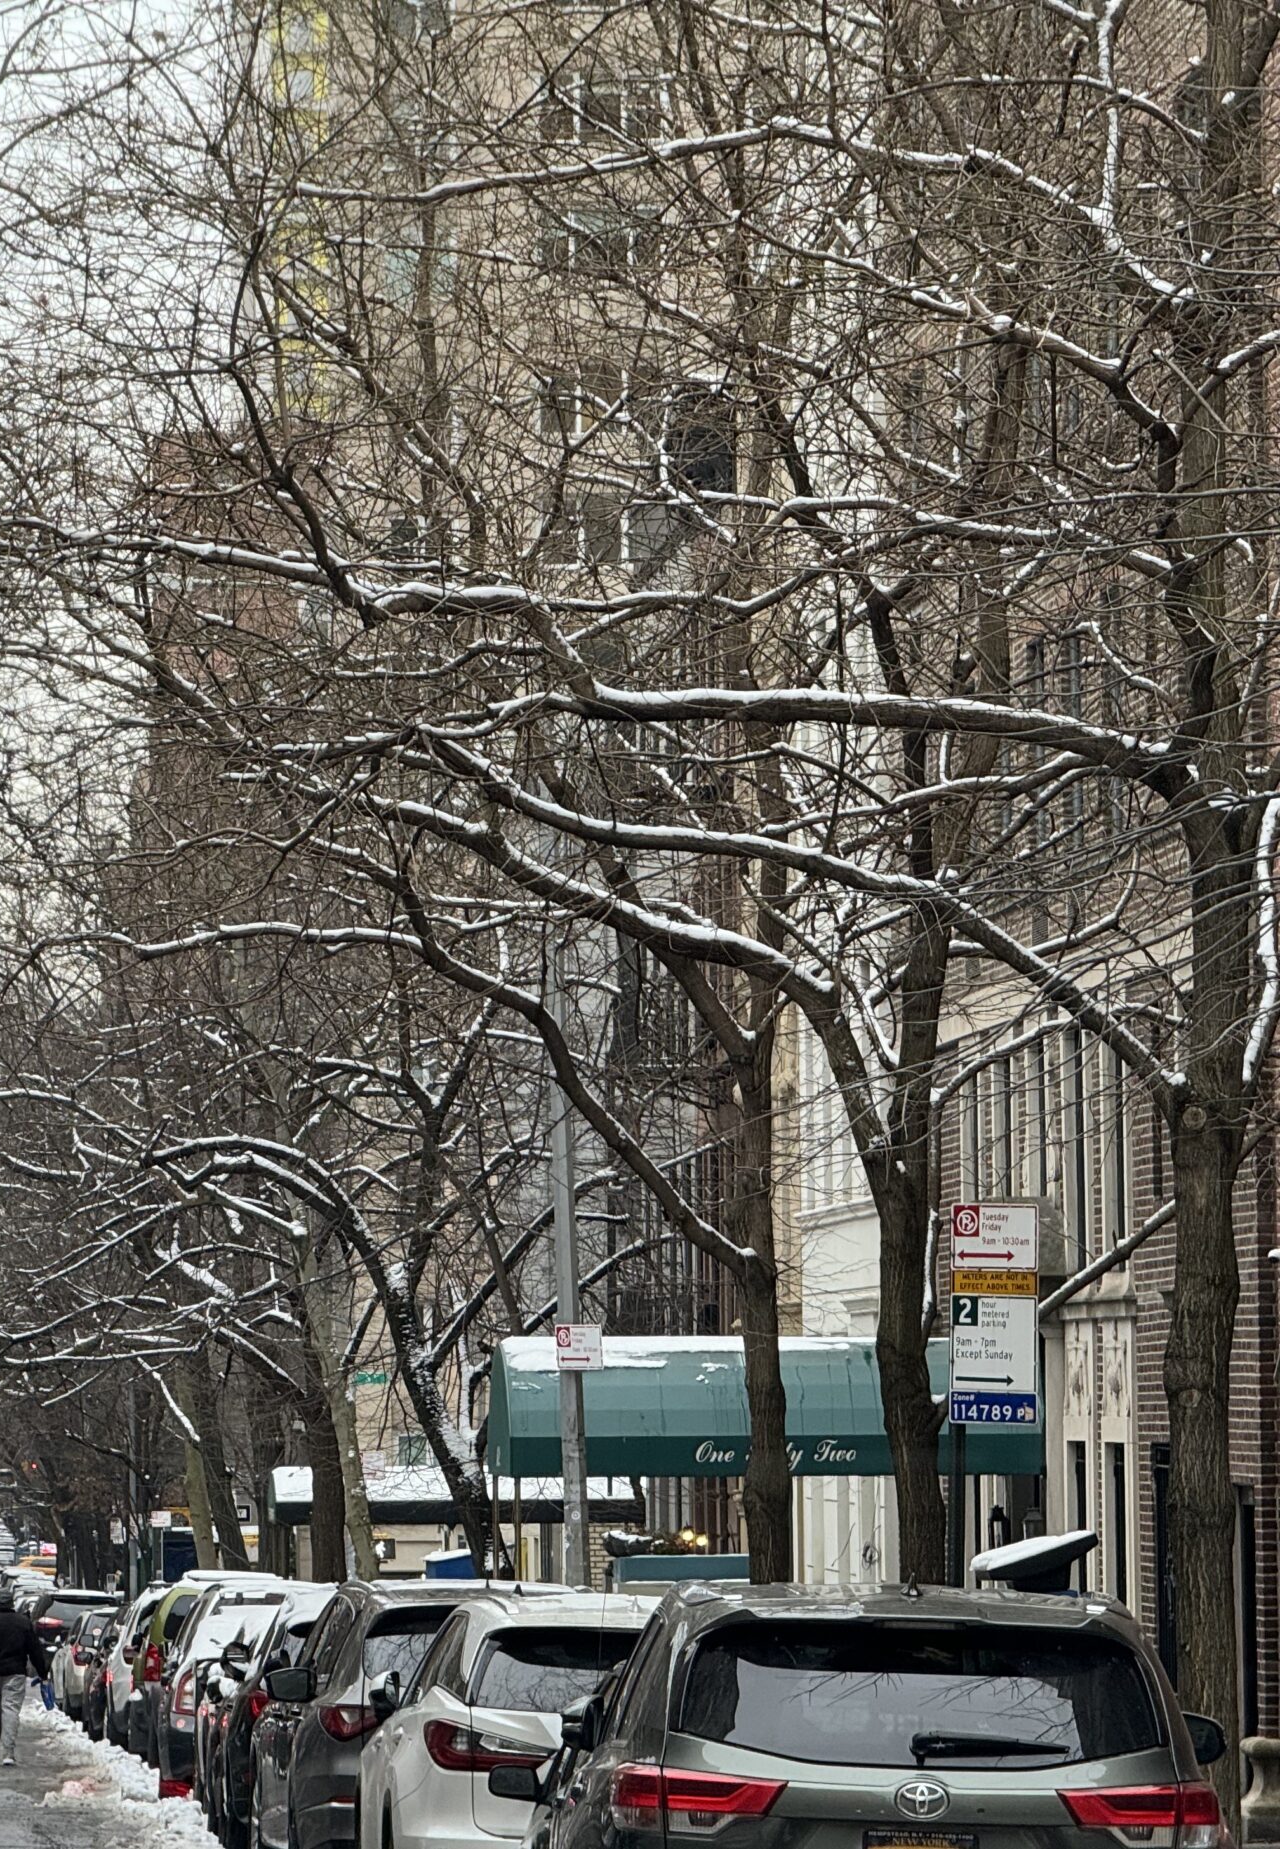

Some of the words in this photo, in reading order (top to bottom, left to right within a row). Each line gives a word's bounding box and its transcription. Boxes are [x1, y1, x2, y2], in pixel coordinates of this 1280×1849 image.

[982, 1213, 1009, 1222] Tuesday
[982, 1223, 1001, 1233] Friday
[982, 1237, 996, 1245] 9am
[1002, 1237, 1029, 1246] 10:30am
[960, 1282, 983, 1290] EFFECT
[959, 1298, 971, 1324] 2
[982, 1311, 1010, 1319] metered
[982, 1320, 1007, 1329] parking
[956, 1337, 972, 1346] 9am
[981, 1337, 997, 1348] 7pm
[956, 1349, 982, 1360] Except
[985, 1350, 1013, 1361] Sunday
[953, 1404, 1012, 1421] 114789
[695, 1440, 735, 1463] One
[814, 1439, 857, 1462] Two
[892, 1838, 918, 1846] NEW
[922, 1838, 950, 1847] YORK
